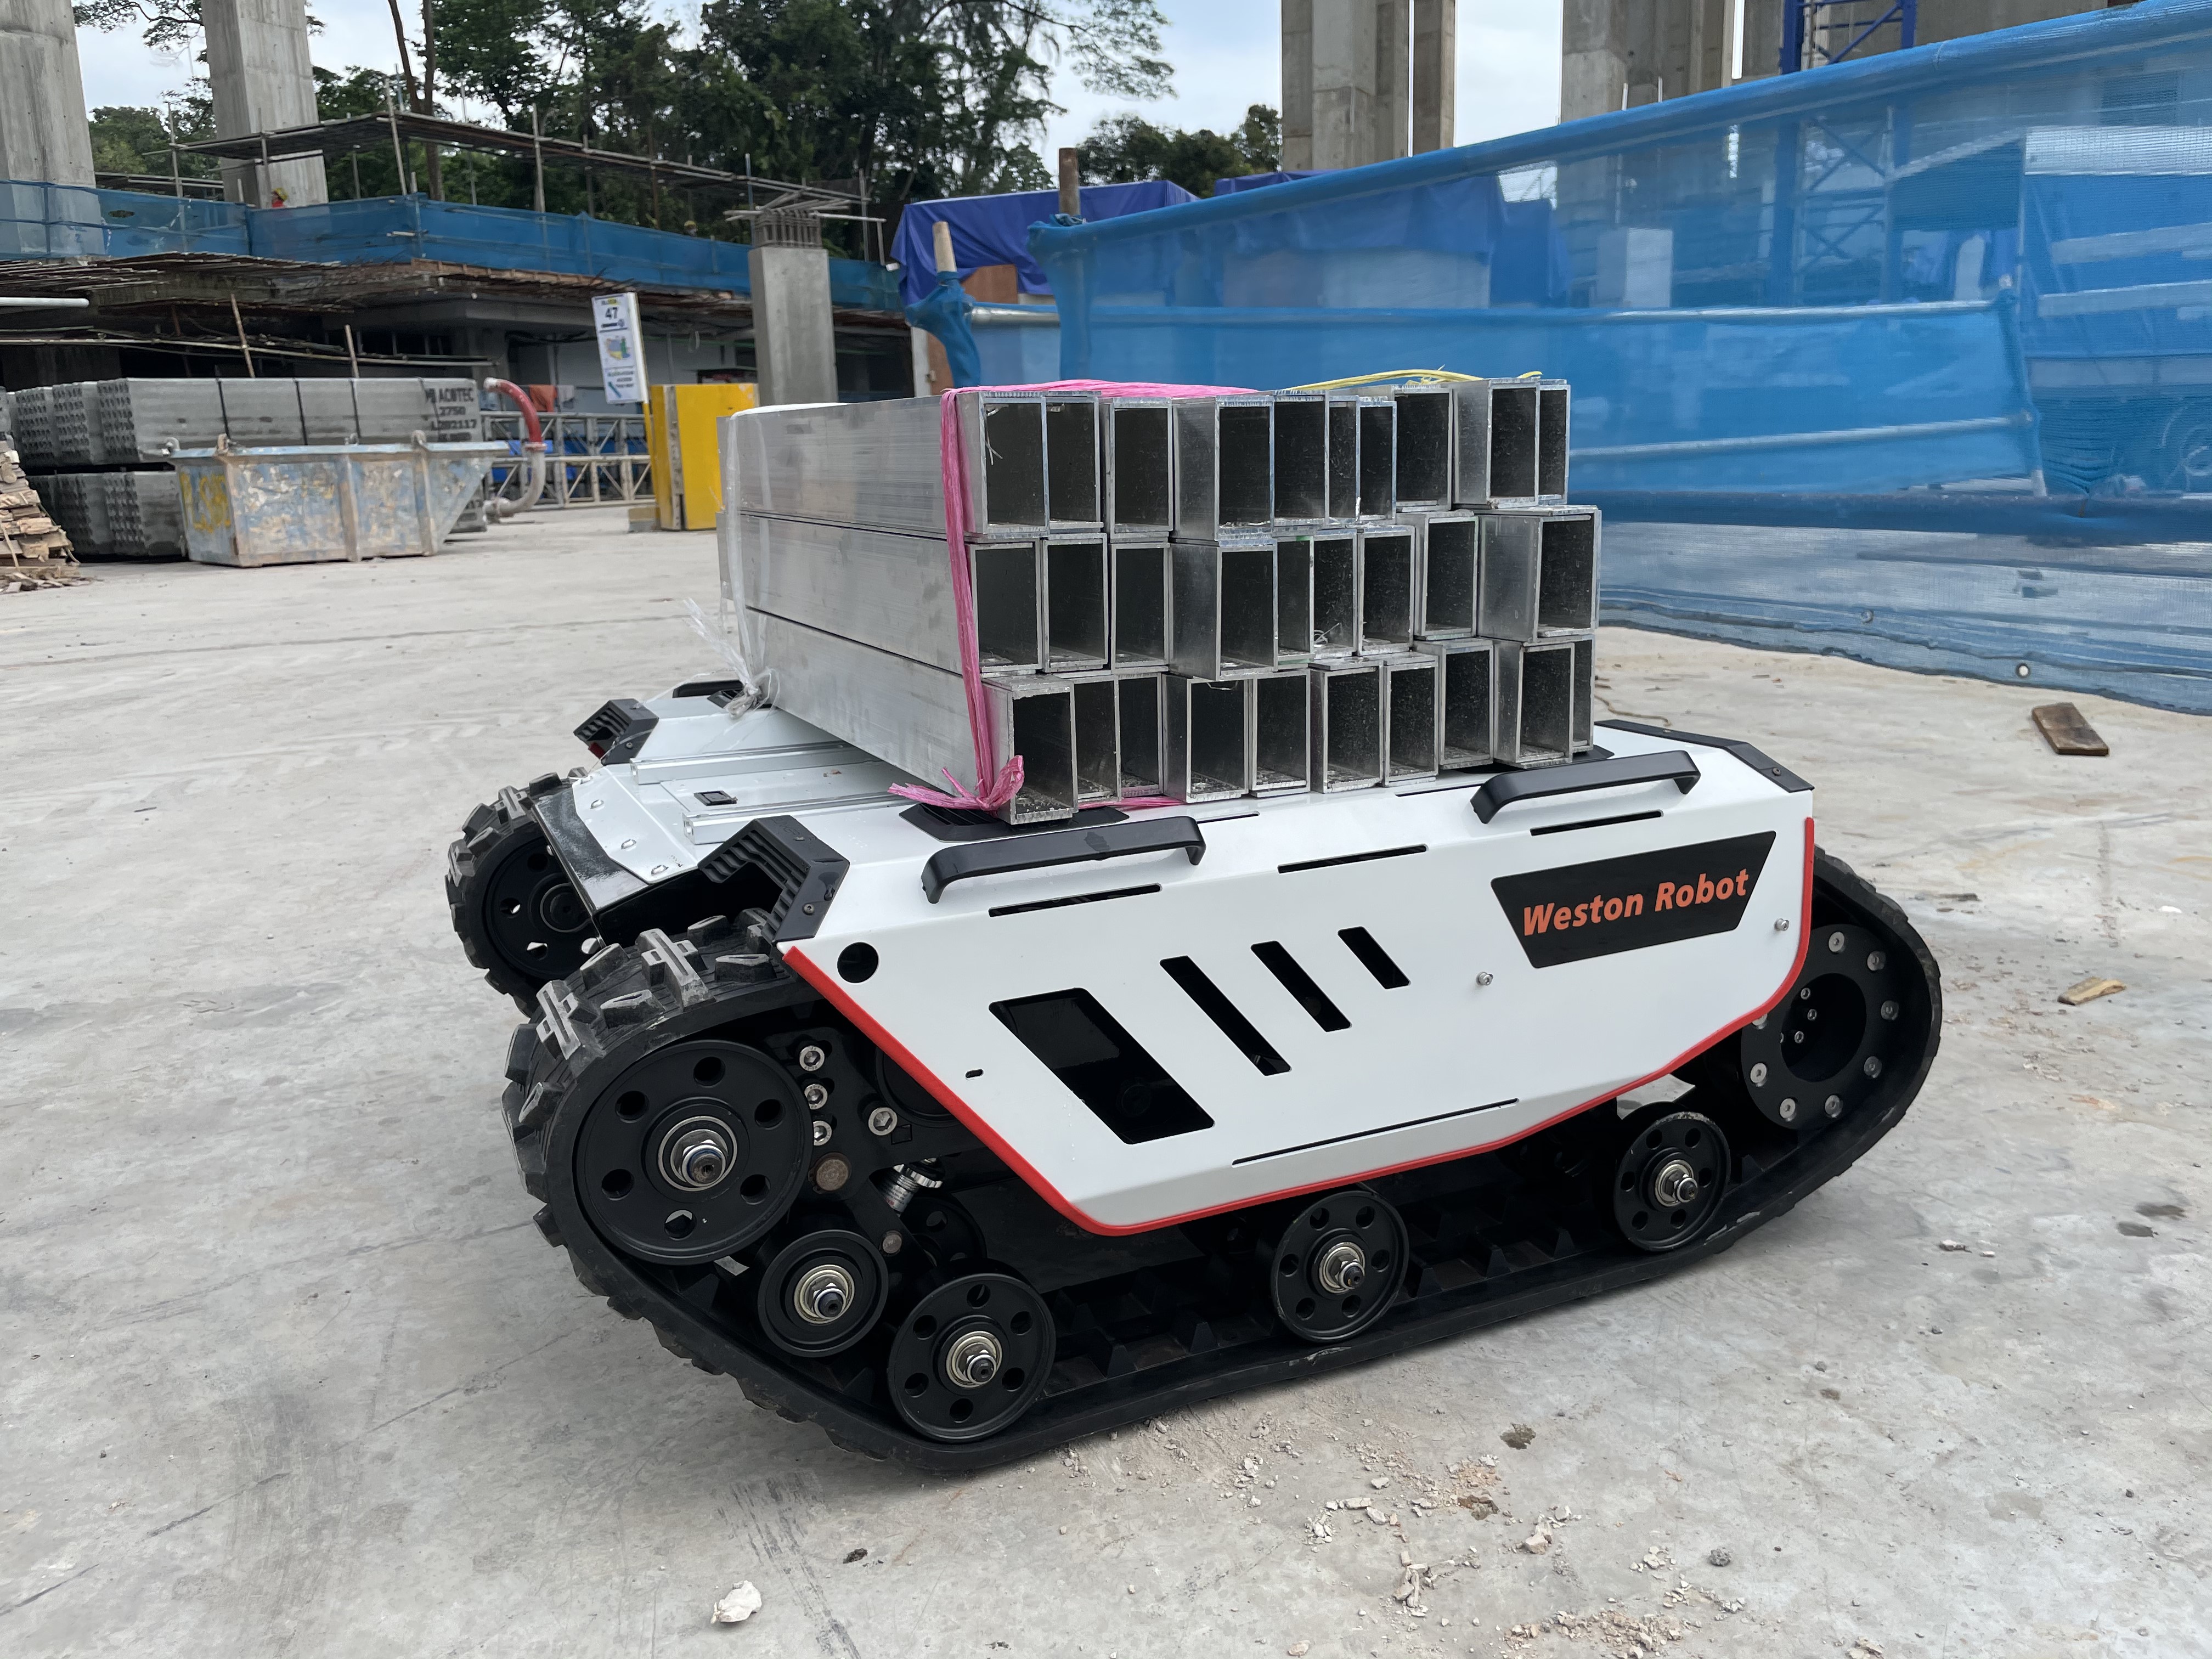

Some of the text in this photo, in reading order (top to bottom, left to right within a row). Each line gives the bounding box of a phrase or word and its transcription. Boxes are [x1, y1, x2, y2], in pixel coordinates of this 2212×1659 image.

[606, 307, 618, 319] 47
[1524, 868, 1748, 936] Weston Robot
